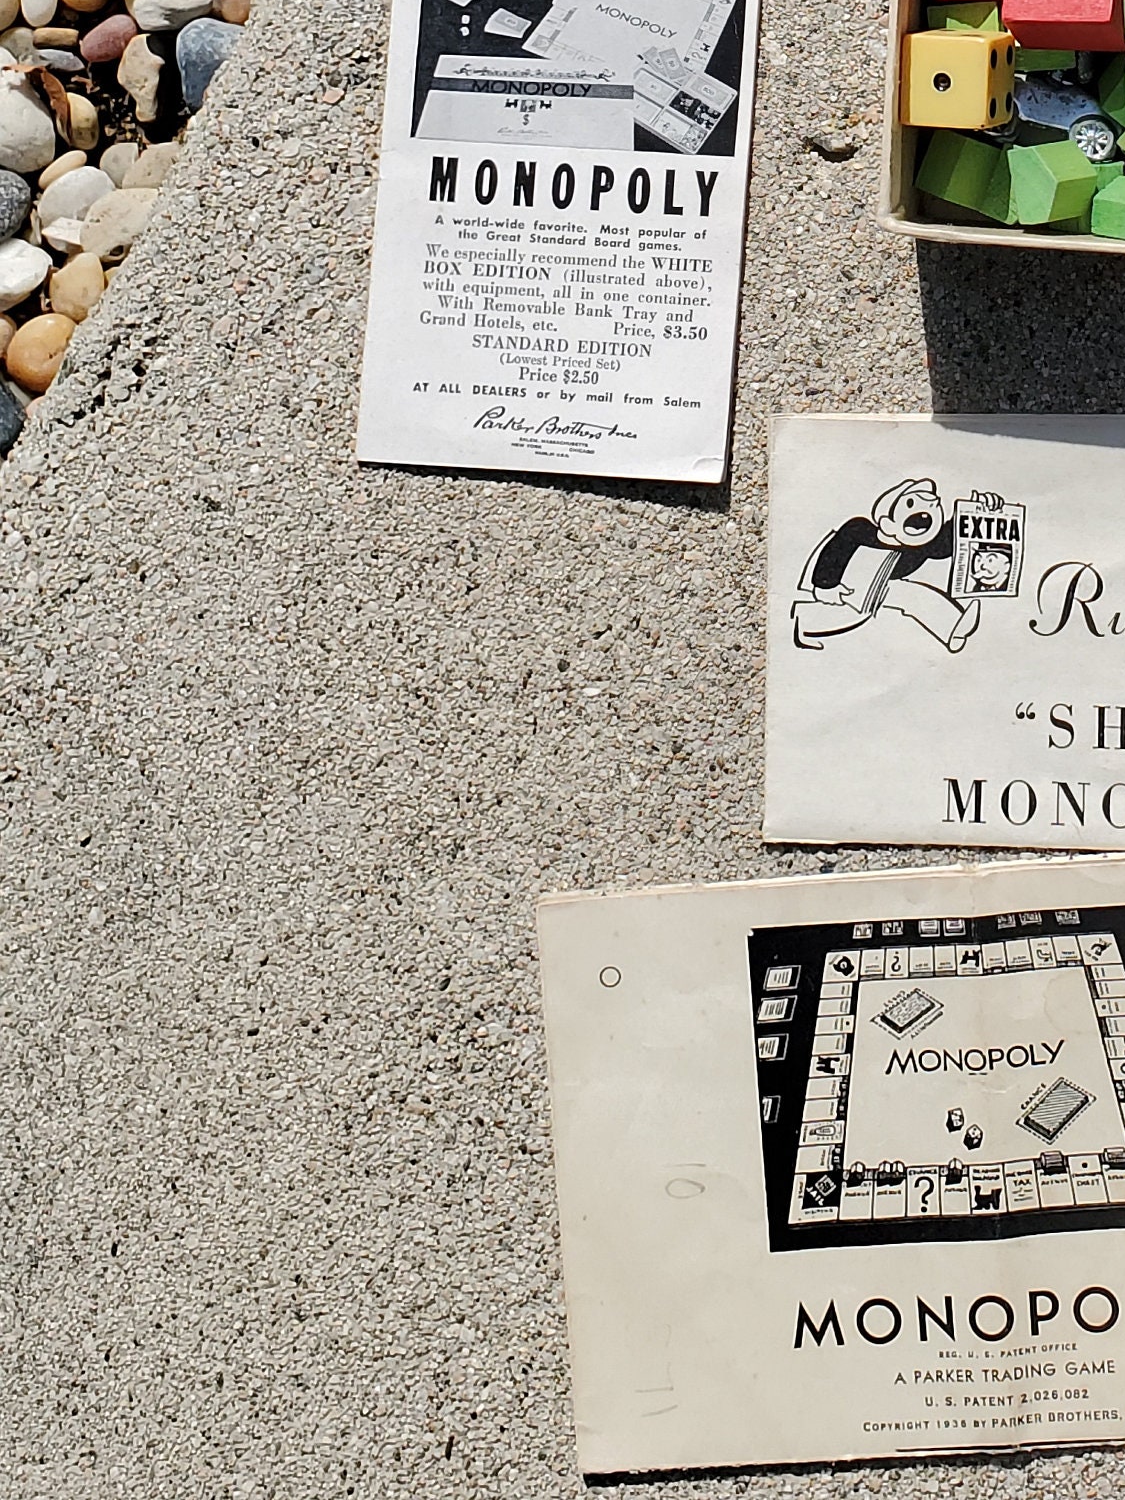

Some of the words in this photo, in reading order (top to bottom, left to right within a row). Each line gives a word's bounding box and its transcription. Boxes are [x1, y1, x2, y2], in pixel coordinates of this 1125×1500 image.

[595, 4, 678, 39] MONOPOLY
[472, 80, 592, 97] MONOPOLY
[429, 156, 718, 217] MONOPOLY
[435, 215, 444, 225] A
[453, 217, 525, 230] world-wide
[534, 221, 588, 233] favorite.
[600, 225, 630, 236] Most
[638, 228, 686, 240] popular
[694, 229, 707, 240] of
[459, 229, 478, 240] the
[486, 231, 521, 243] Great
[529, 233, 585, 246] Standard
[594, 237, 630, 249] Board
[638, 240, 682, 252] games.
[426, 243, 449, 258] We
[454, 247, 526, 264] especially
[531, 252, 618, 269] recommend
[622, 256, 645, 269] the
[651, 256, 713, 273] WHITE
[424, 260, 462, 276] BOX
[472, 263, 552, 281] EDITION
[563, 267, 645, 286] (illustrated
[655, 273, 712, 292] above),
[423, 278, 455, 292] with
[462, 282, 545, 299] equipment,
[553, 286, 571, 299] all
[581, 288, 594, 300] in
[603, 291, 629, 302] one
[637, 292, 712, 307] container.
[438, 294, 474, 310] With
[484, 298, 565, 316] Removable
[575, 304, 612, 318] Bank
[622, 306, 657, 323] Tray
[666, 309, 694, 323] and
[420, 312, 466, 328] Grand
[474, 314, 525, 331] Hotels,
[532, 319, 558, 332] etc.
[613, 322, 656, 339] Price,
[663, 325, 708, 340] $3.50
[472, 335, 569, 353] STANDARD
[578, 340, 652, 357] EDITION
[499, 352, 548, 367] (Lowest
[553, 356, 591, 370] Priced
[596, 358, 621, 372] Set)
[519, 367, 558, 383] Price
[563, 369, 599, 386] $2.50
[413, 382, 429, 393] AT
[439, 383, 461, 394] ALL
[473, 385, 527, 398] DEALERS
[537, 389, 550, 399] or
[560, 390, 576, 403] by
[586, 392, 613, 403] mail
[624, 393, 654, 405] from
[663, 397, 701, 409] Salem
[473, 406, 535, 434] Parker
[535, 416, 602, 440] Brothers
[959, 515, 1020, 541] EXTRA
[885, 1039, 1066, 1075] MONOPOLY
[1000, 1346, 1037, 1358] PATENT
[1041, 1343, 1078, 1353] OFFICE
[894, 1372, 907, 1385] A
[914, 1369, 974, 1384] PARKER
[982, 1363, 1056, 1383] TRADING
[1065, 1360, 1115, 1375] GAME
[925, 1396, 938, 1407] U.
[945, 1396, 957, 1406] S.
[964, 1395, 1014, 1407] PATENT
[863, 1420, 929, 1432] COPYRIGHT
[992, 1413, 1042, 1428] PARKER
[1049, 1410, 1123, 1423] BROTHERS,
